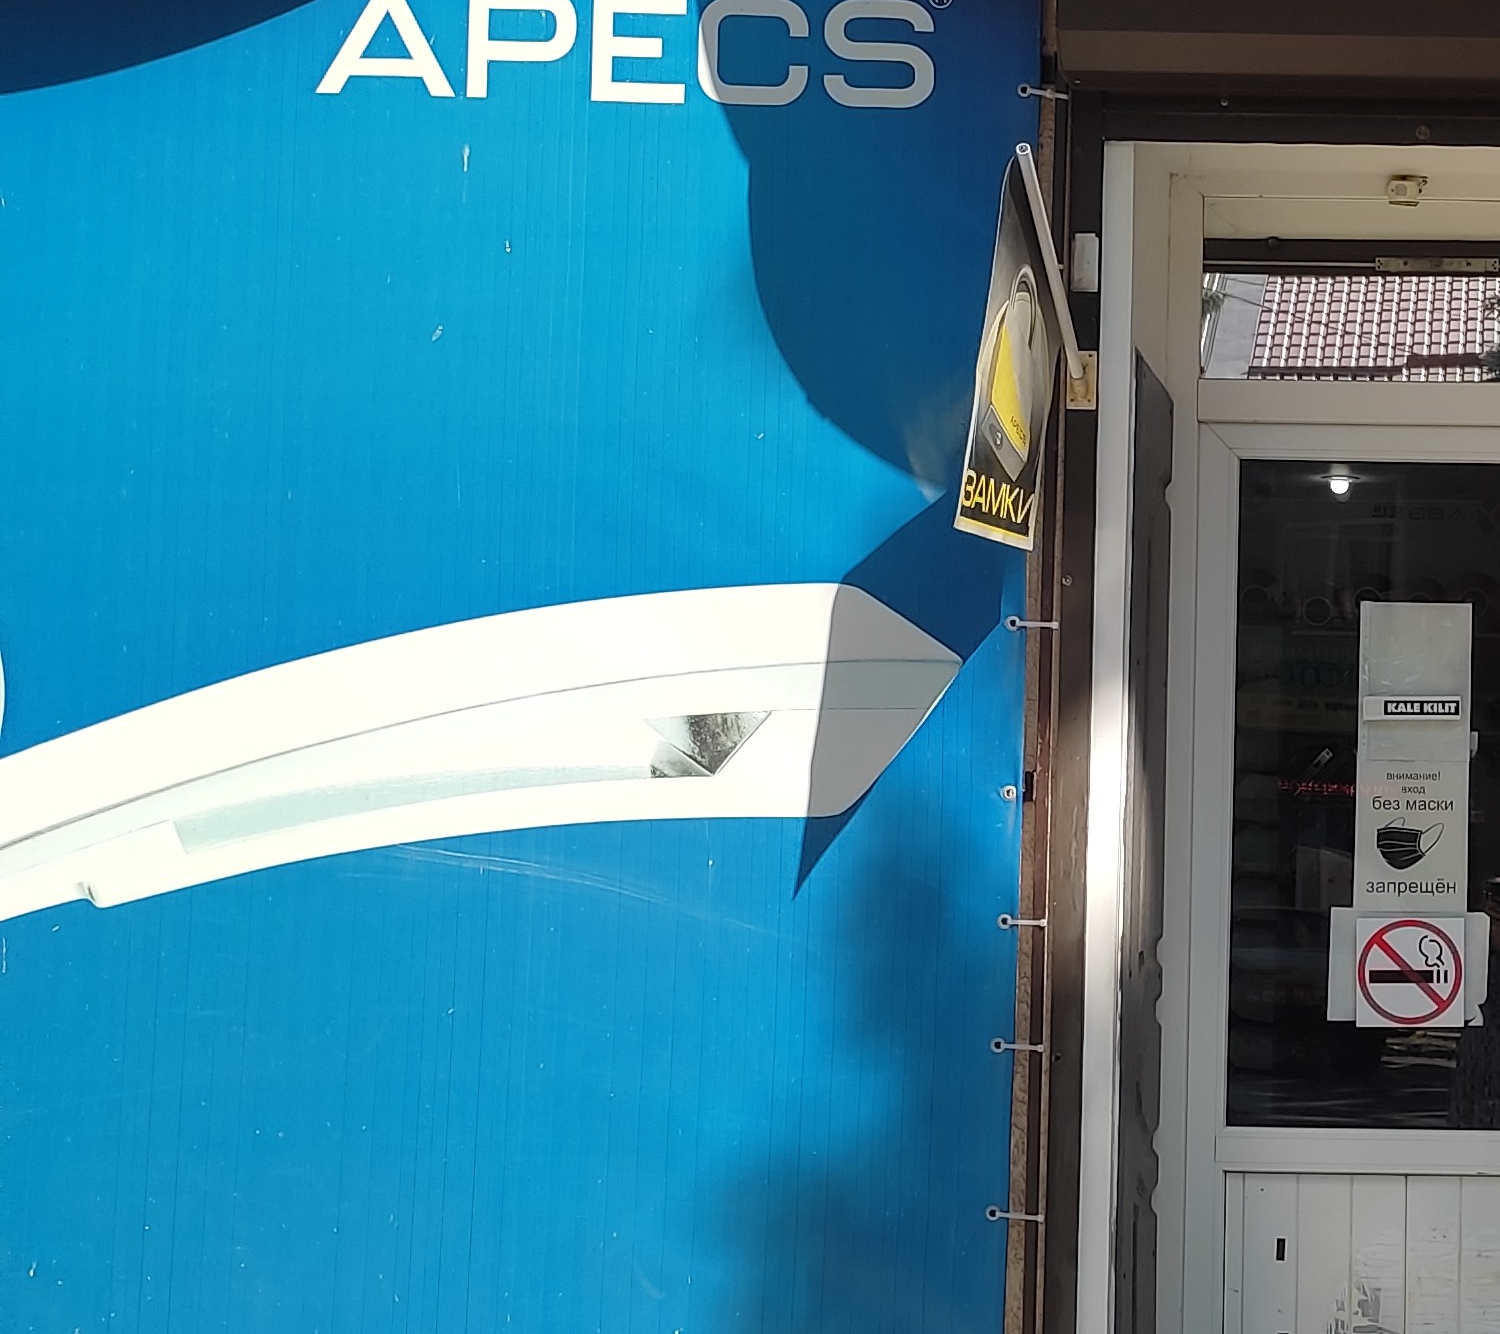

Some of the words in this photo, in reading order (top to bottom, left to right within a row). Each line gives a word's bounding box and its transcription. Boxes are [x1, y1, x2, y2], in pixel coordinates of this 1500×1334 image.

[962, 468, 1034, 523] ЗАМКИ
[1386, 702, 1421, 713] KALE
[1423, 702, 1457, 713] KILIT
[1386, 771, 1441, 781] внимание!
[1401, 786, 1426, 795] вход
[1372, 796, 1401, 811] без
[1405, 799, 1454, 811] маски
[1365, 878, 1456, 897] запрещён
